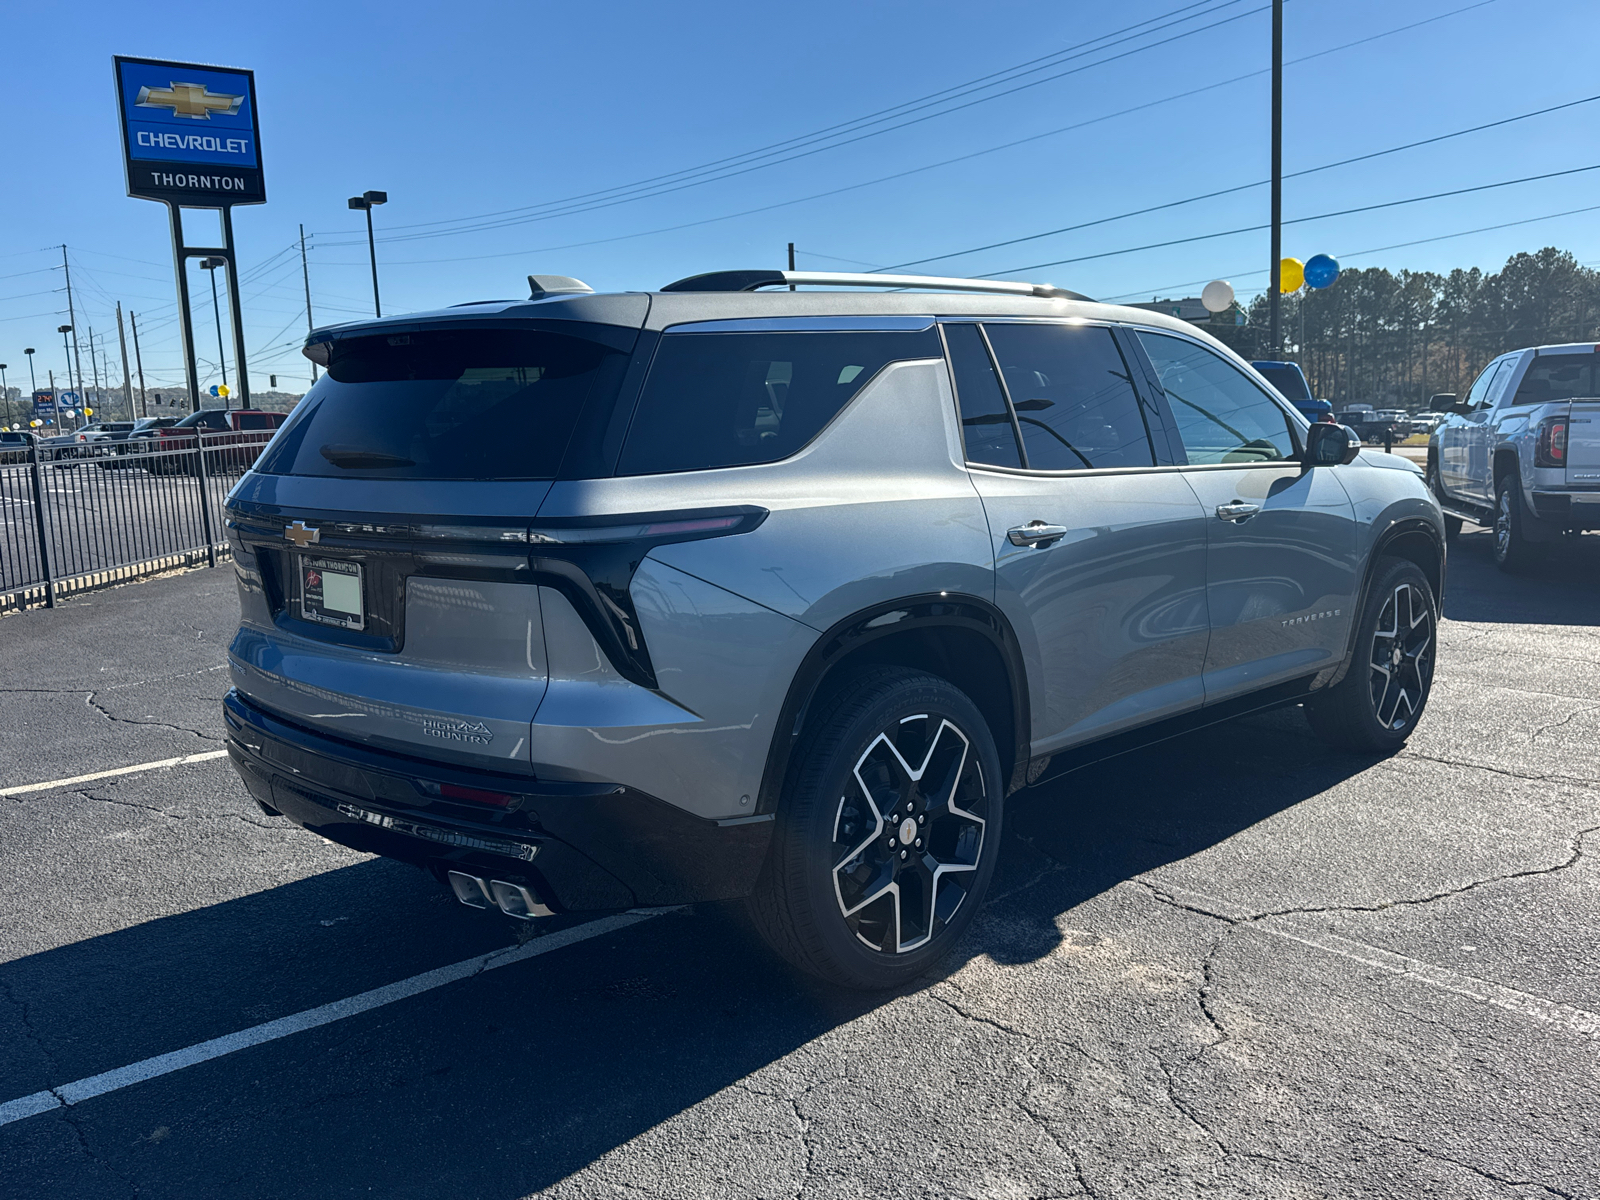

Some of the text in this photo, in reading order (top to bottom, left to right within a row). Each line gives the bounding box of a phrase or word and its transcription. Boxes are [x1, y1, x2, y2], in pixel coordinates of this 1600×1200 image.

[137, 131, 248, 153] CHEVROLET
[151, 172, 244, 190] THORNTON
[327, 561, 357, 572] THORNTON
[1282, 609, 1340, 627] TRAVERSE
[875, 696, 959, 726] CONTINENTAL
[424, 720, 457, 731] HIGH
[424, 729, 489, 744] COUNTRY
